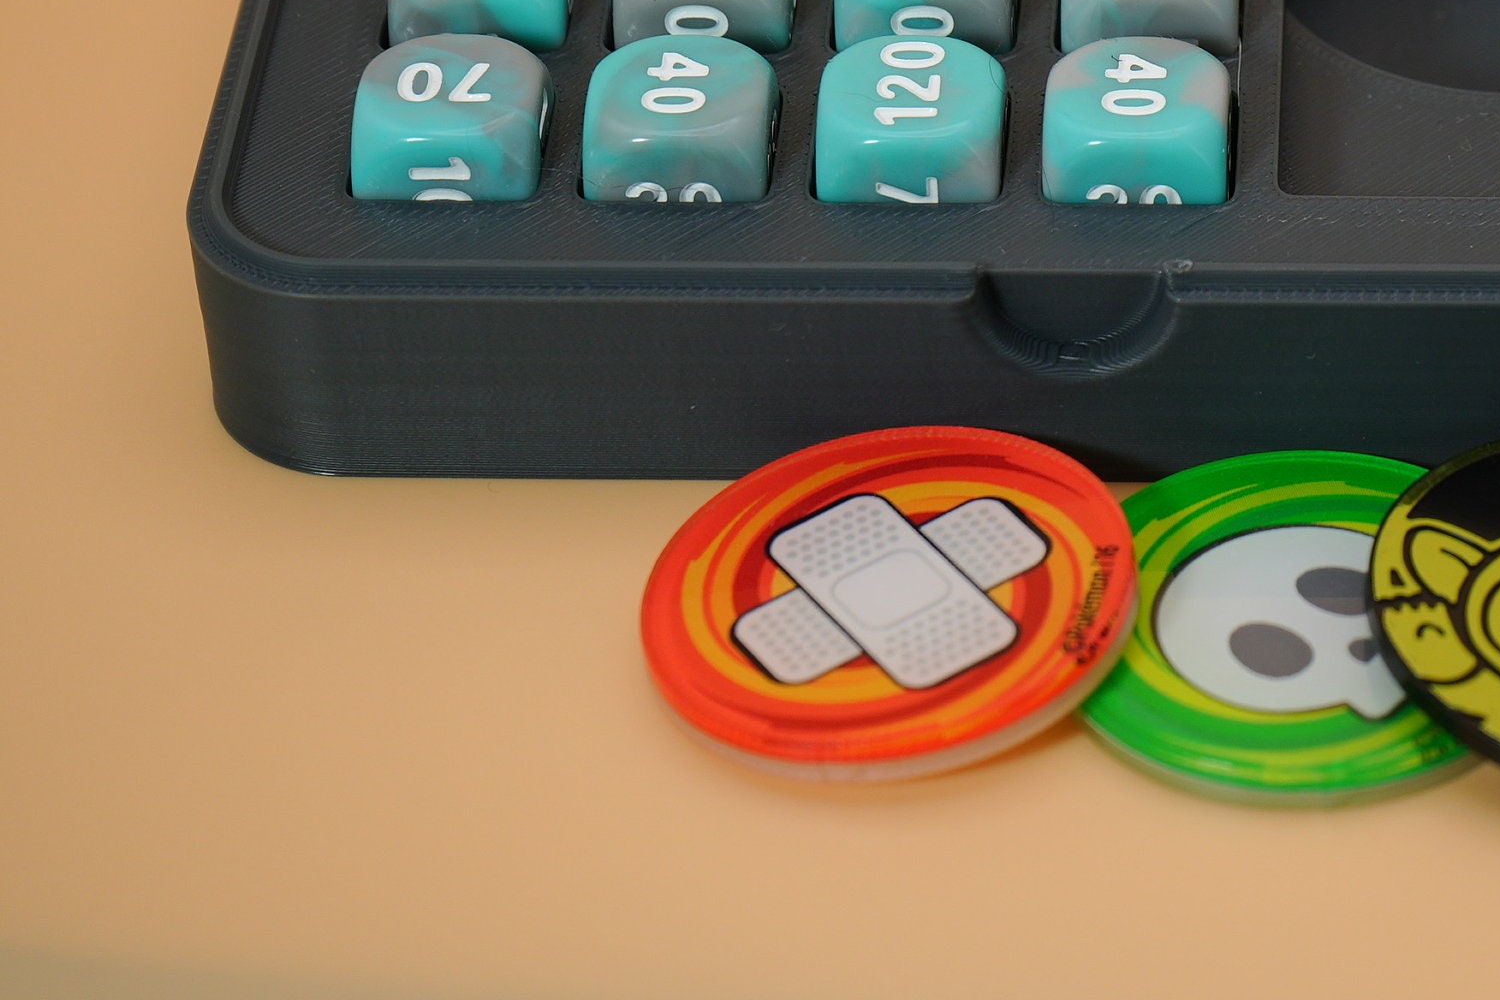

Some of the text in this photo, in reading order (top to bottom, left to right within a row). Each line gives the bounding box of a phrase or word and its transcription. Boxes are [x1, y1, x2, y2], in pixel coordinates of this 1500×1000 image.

[396, 62, 493, 103] 70
[640, 51, 711, 115] 40
[873, 41, 947, 127] 120
[1100, 52, 1168, 117] 40
